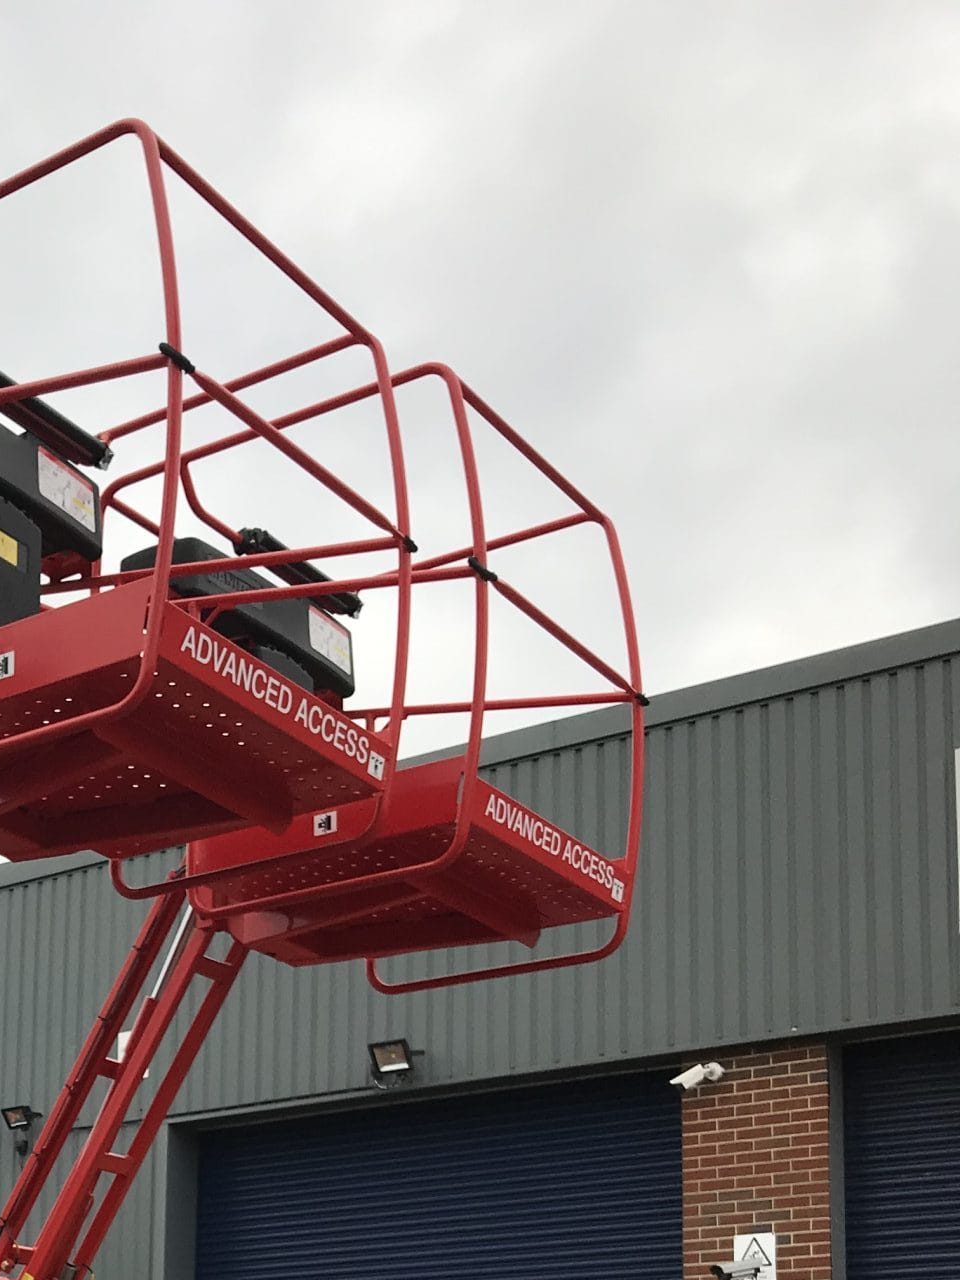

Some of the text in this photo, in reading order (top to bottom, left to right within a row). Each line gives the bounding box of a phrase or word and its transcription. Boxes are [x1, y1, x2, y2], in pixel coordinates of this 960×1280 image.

[180, 626, 293, 714] ADVANCED
[294, 698, 369, 764] ACCESS
[485, 794, 614, 889] ADVANCED ACCESS
